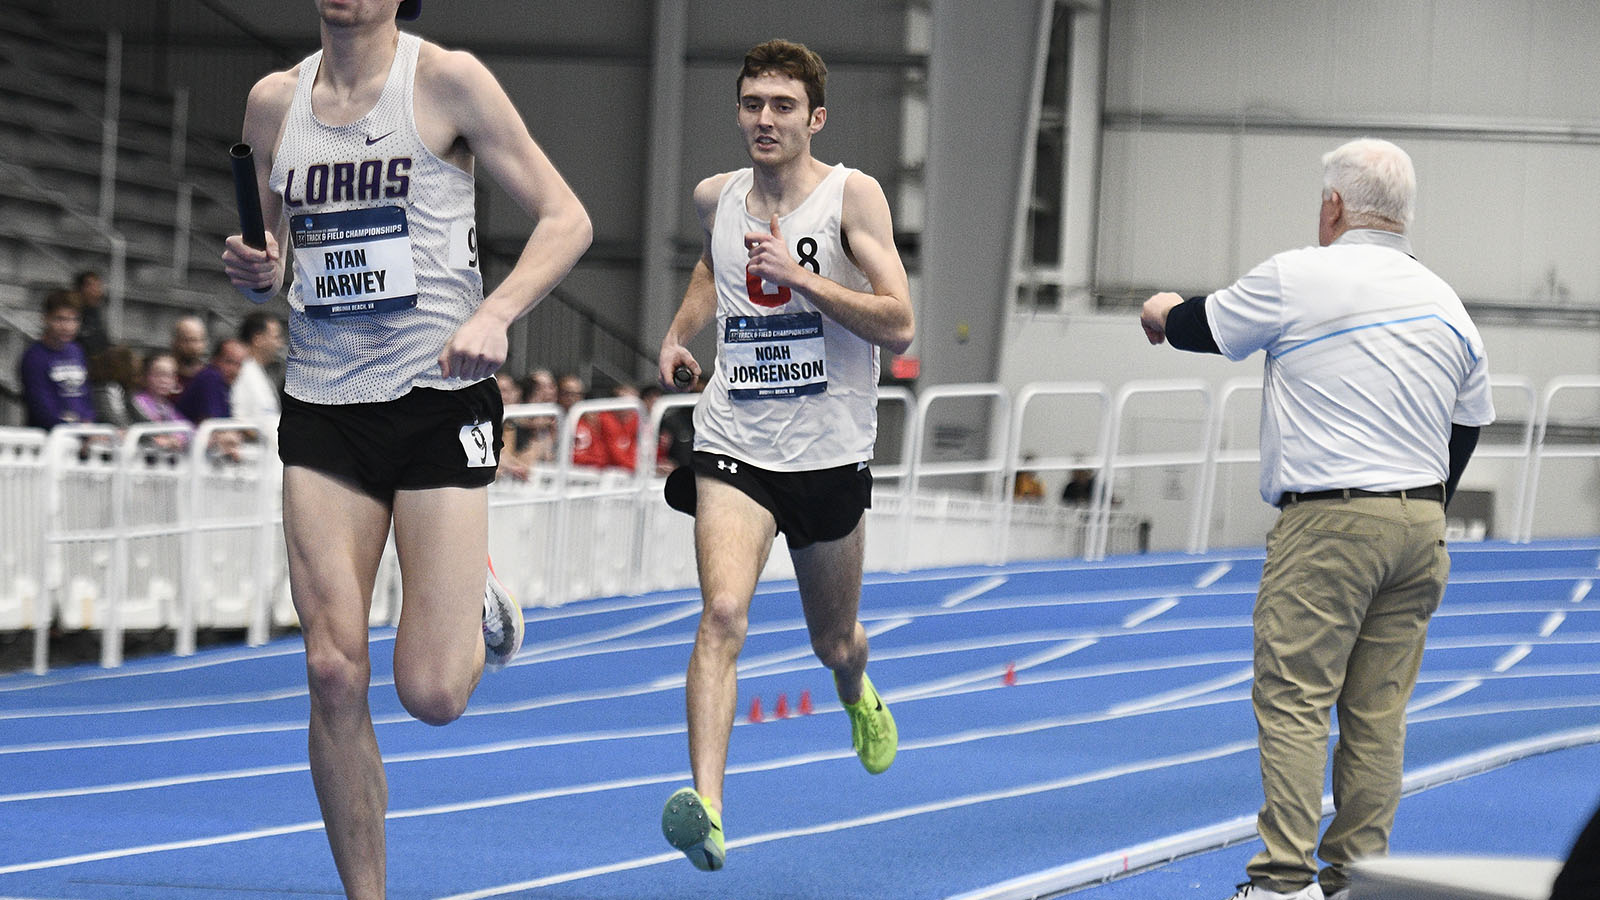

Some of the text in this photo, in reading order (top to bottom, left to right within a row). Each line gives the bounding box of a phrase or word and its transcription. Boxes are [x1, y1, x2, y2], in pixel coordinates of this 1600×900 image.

[284, 157, 412, 207] LORAS
[306, 233, 322, 242] TRACK
[327, 230, 345, 241] FIELD
[345, 224, 403, 239] CHAMPIONSHIPS
[324, 248, 367, 271] RYAN
[467, 226, 478, 268] 9
[796, 236, 821, 275] 8
[315, 269, 387, 299] HARVEY
[758, 330, 772, 339] FIELD
[772, 327, 819, 338] CHAMPIONSHIPS
[755, 345, 791, 361] NOAH
[729, 359, 824, 384] JORGENSON
[471, 426, 487, 465] 9
